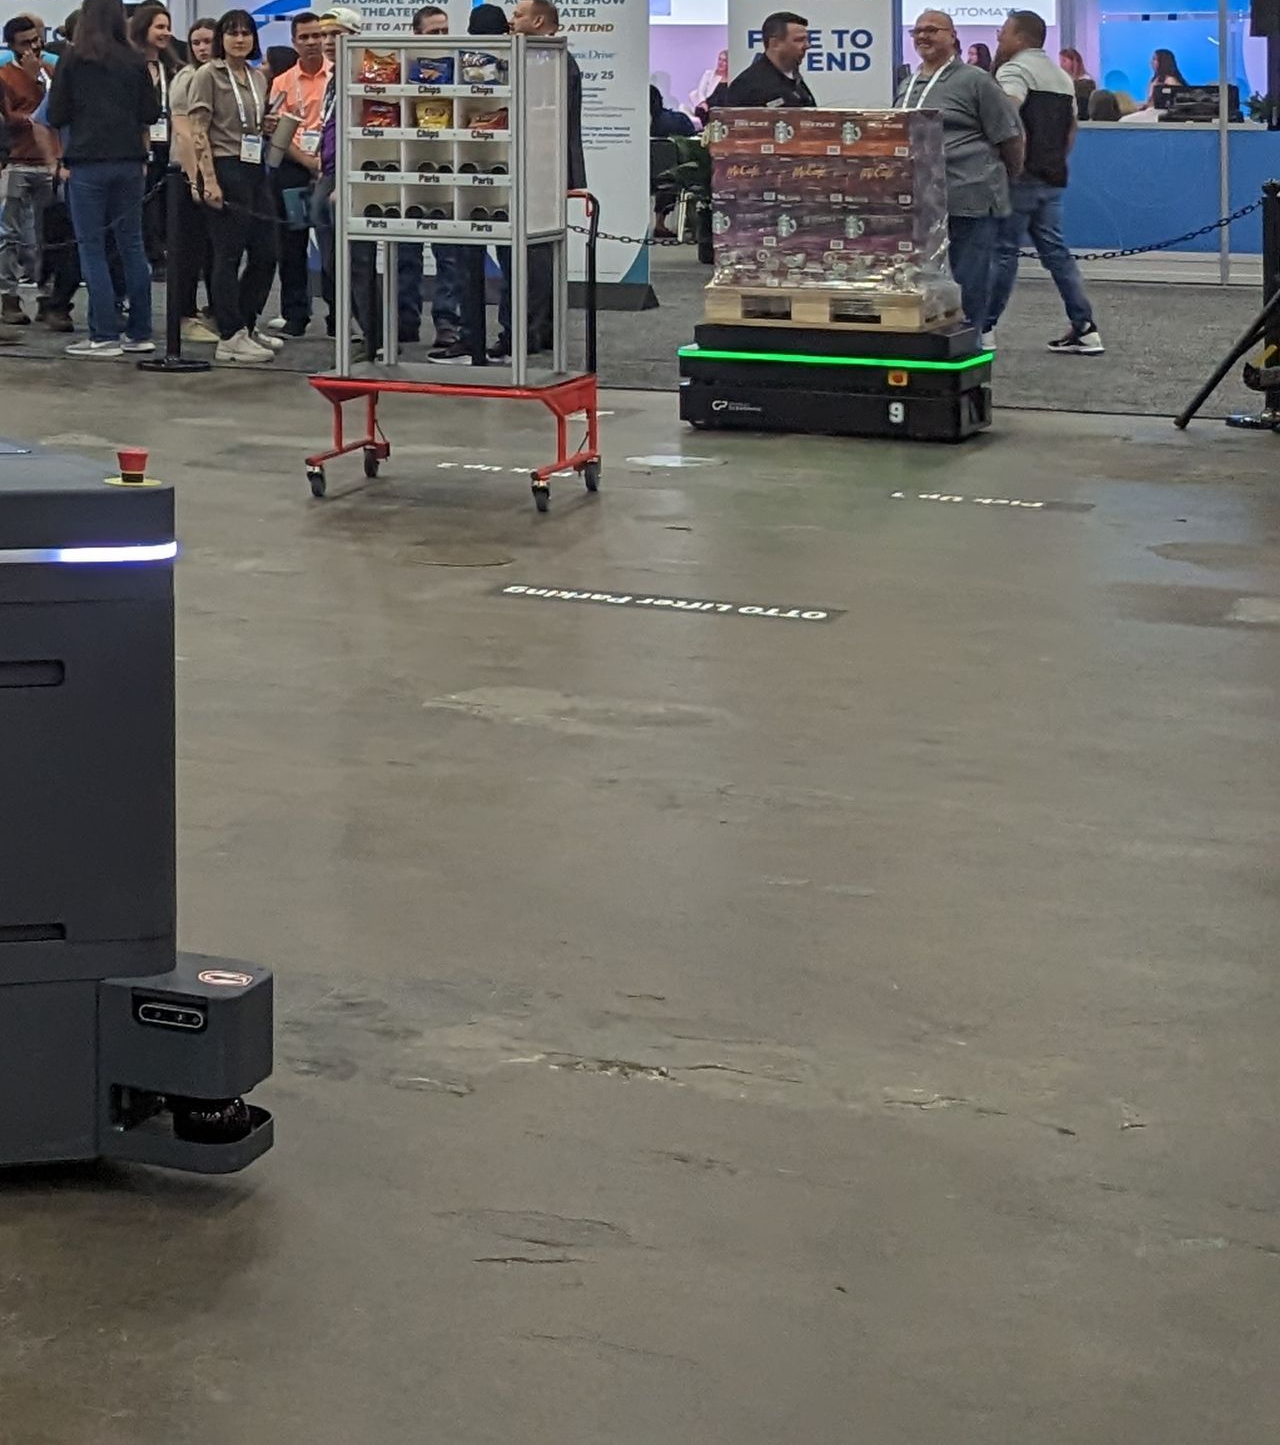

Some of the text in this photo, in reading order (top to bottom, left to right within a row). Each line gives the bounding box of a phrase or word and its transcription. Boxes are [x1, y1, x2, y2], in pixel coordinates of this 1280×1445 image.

[376, 23, 388, 31] TO
[565, 23, 614, 32] ATTEND
[747, 29, 873, 49] FE TO
[600, 71, 614, 80] 25
[364, 86, 386, 95] Chips
[418, 86, 441, 95] Chips
[470, 85, 493, 95] Chips
[362, 129, 384, 138] Chips
[417, 129, 439, 139] Chips
[471, 130, 494, 140] Chips
[364, 173, 385, 181] Parts
[419, 174, 440, 183] Parts
[472, 176, 494, 185] Parts
[366, 220, 387, 229] Parts
[417, 221, 438, 230] Parts
[471, 223, 492, 232] Parts
[889, 401, 904, 424] 9
[973, 496, 1044, 509] Pick
[503, 585, 827, 620] OTTO Lifter Parking
